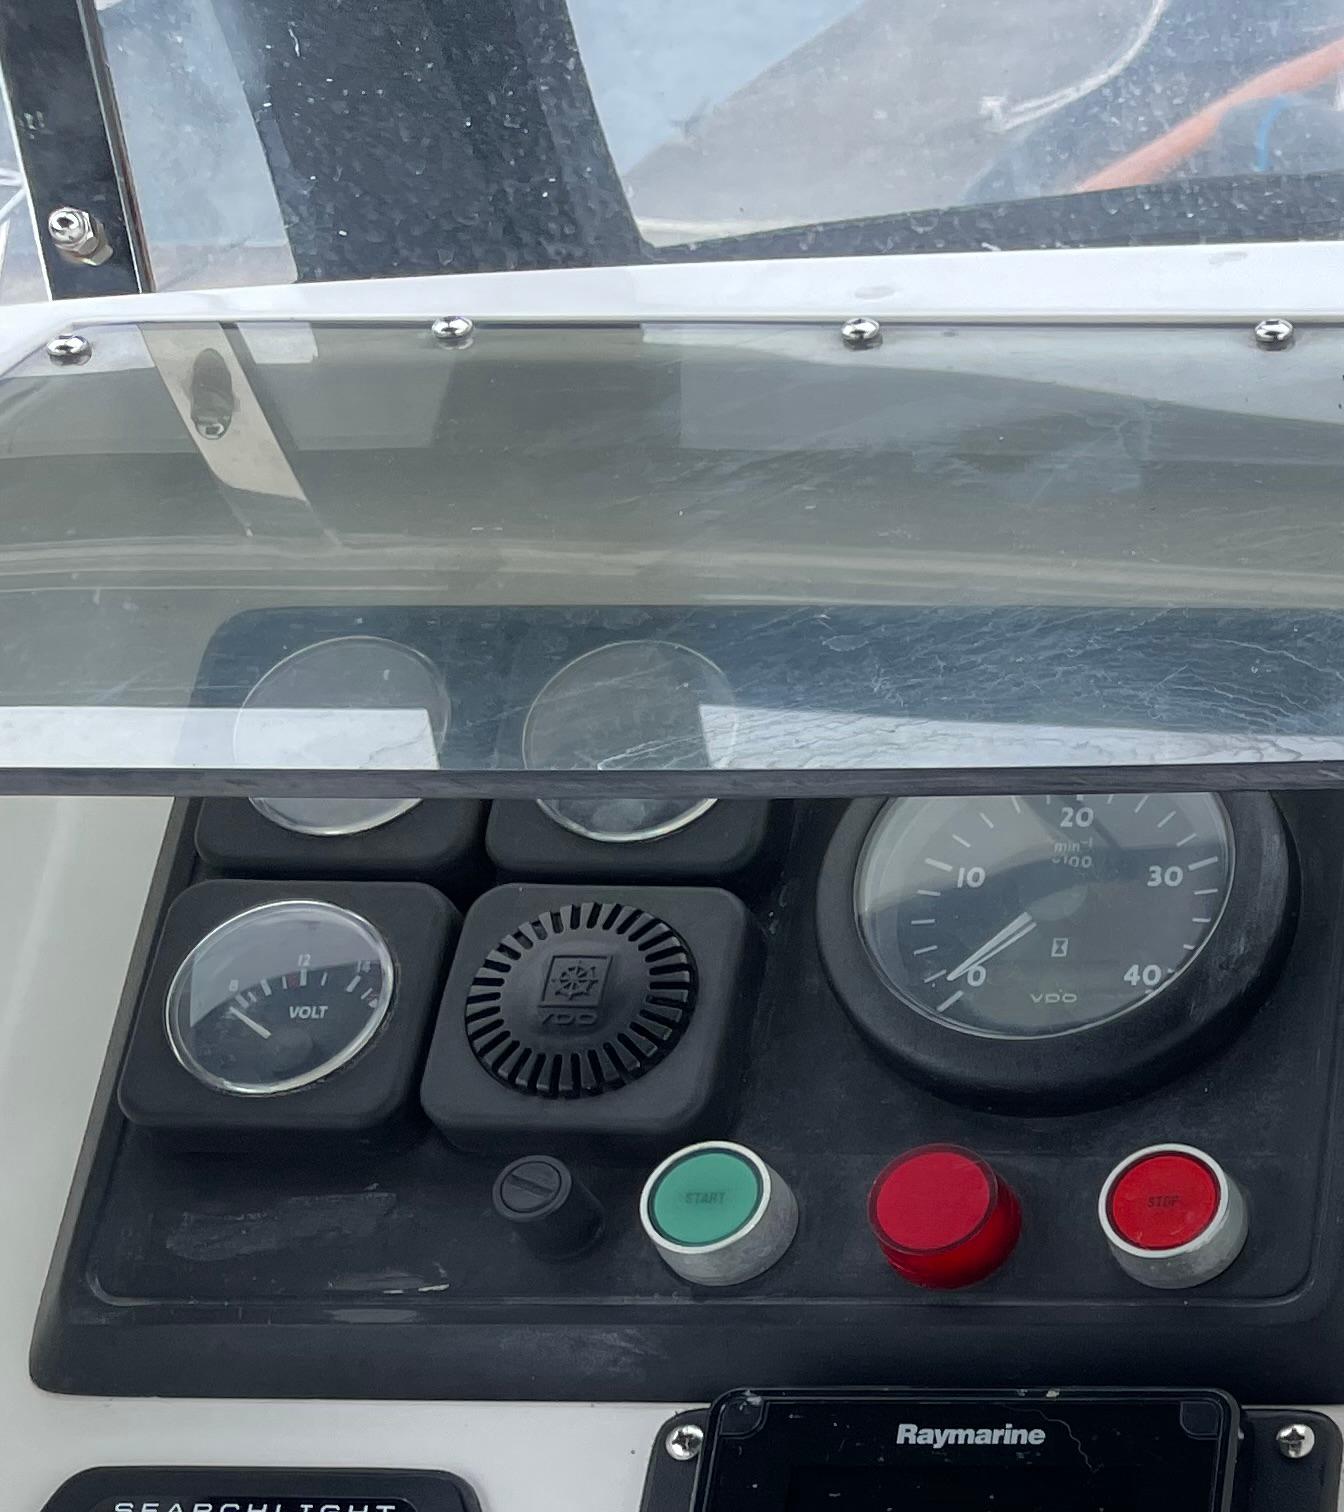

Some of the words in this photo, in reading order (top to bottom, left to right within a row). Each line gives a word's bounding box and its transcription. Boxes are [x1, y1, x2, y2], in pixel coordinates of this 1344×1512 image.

[1060, 807, 1094, 828] 20
[957, 867, 986, 889] 10
[1147, 865, 1184, 887] 30
[298, 953, 312, 967] 12
[966, 965, 987, 987] 0
[1123, 964, 1162, 986] 40
[1029, 992, 1078, 1004] VDO
[289, 1005, 329, 1019] VOLT
[684, 1190, 727, 1206] START
[896, 1422, 1046, 1449] Raymarine
